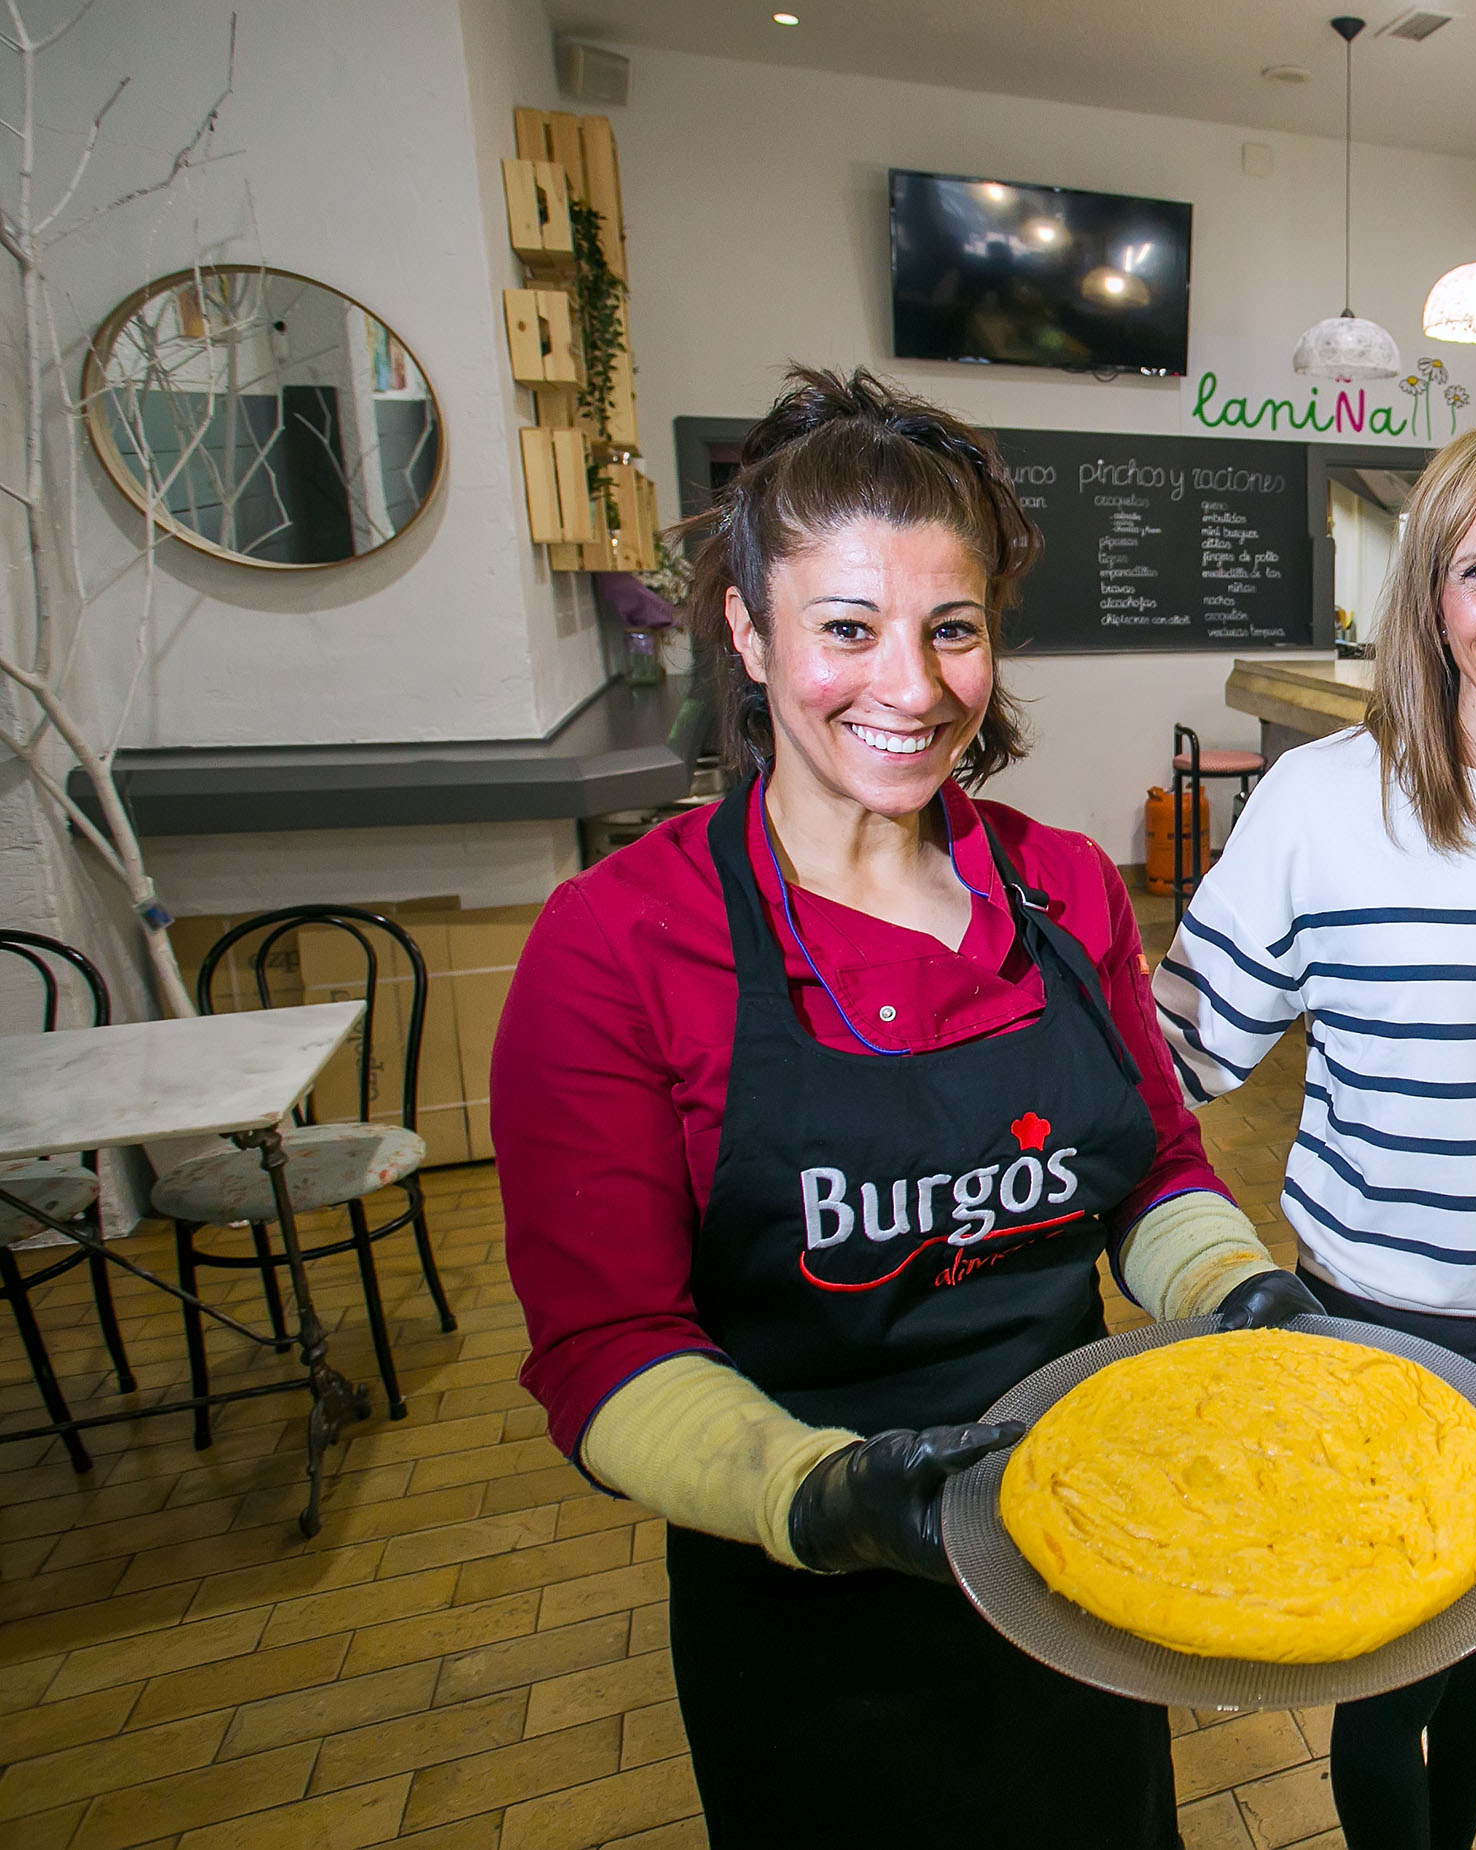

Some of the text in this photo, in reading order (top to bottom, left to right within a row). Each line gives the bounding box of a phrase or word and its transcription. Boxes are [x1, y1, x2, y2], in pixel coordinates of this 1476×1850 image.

[1079, 458, 1286, 501] pinchos y raciones
[1238, 549, 1252, 562] de
[1100, 580, 1136, 595] bravas
[1099, 596, 1158, 612] alcachofas
[800, 1146, 1078, 1247] Burgos
